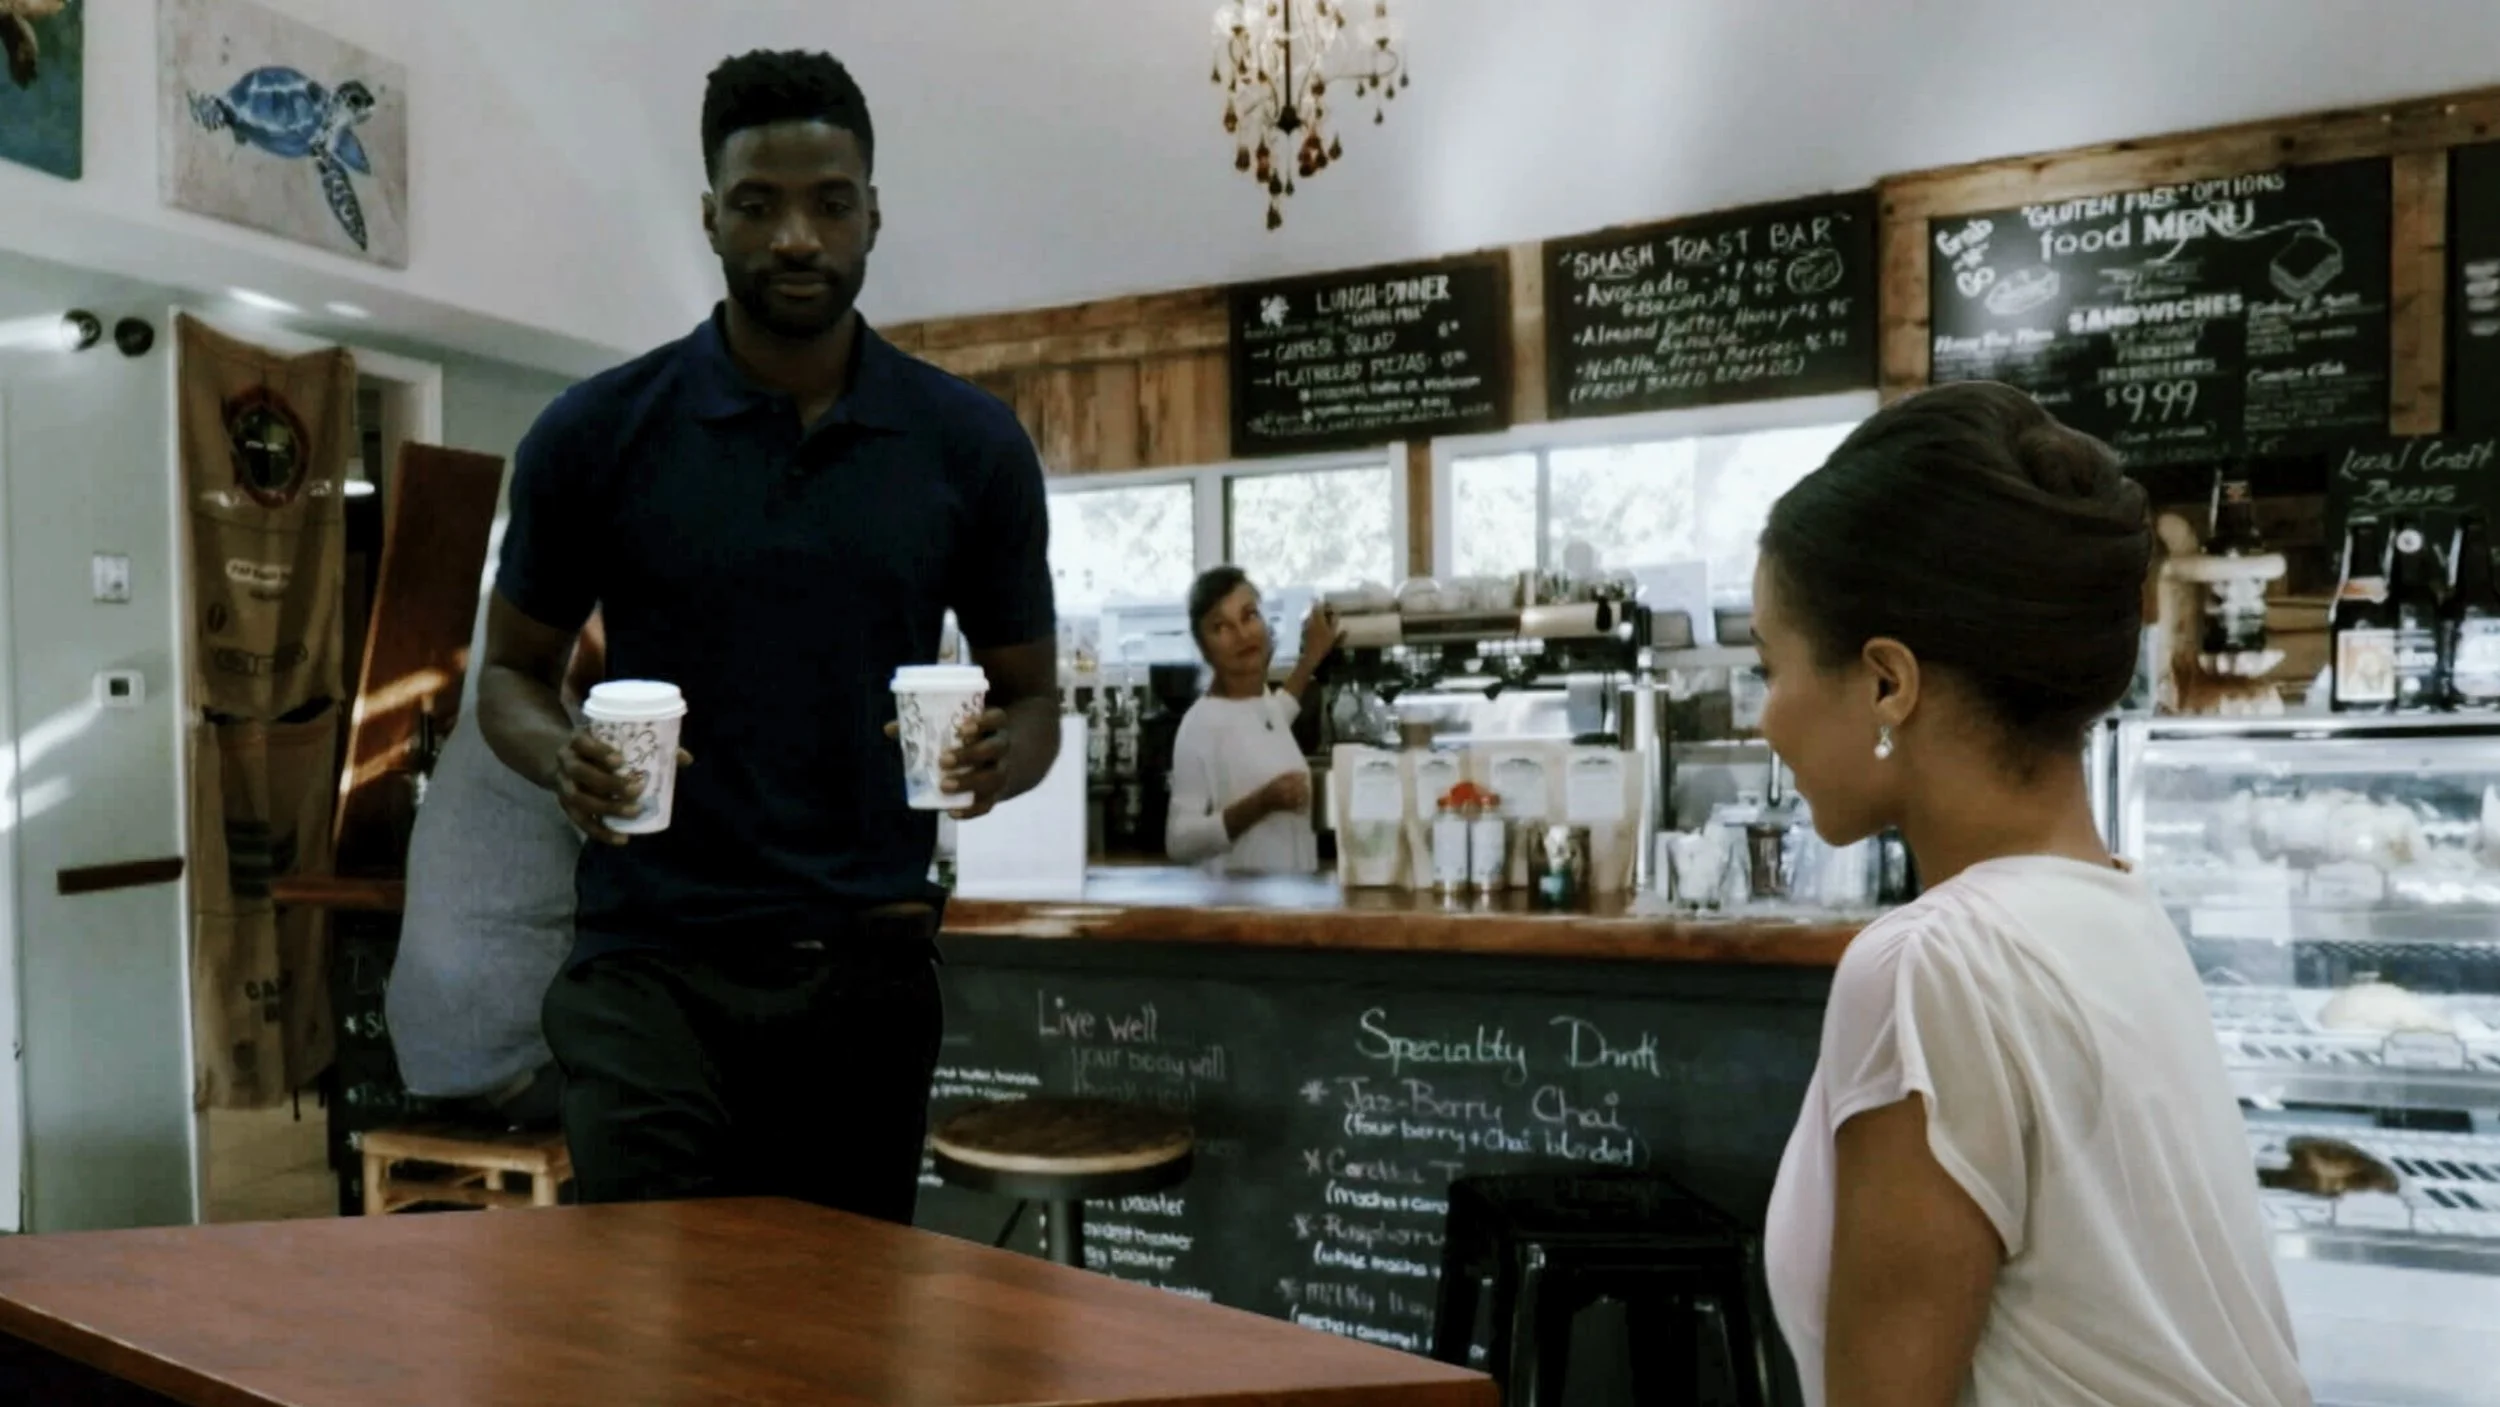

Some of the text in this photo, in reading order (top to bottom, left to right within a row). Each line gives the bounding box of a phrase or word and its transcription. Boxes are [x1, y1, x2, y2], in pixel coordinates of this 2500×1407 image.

[2192, 173, 2286, 203] OPTIONS
[1573, 215, 1832, 281] SMASH TOAST BAR
[1936, 218, 1994, 257] Grab
[2039, 199, 2256, 260] food MENU
[1586, 270, 1690, 308] Avocado
[1956, 266, 1996, 297] Go
[1581, 319, 1660, 348] Almond
[2067, 292, 2244, 334] SANDWICHES
[2105, 379, 2198, 424] $9.99
[2339, 439, 2498, 482] Local Craft
[2352, 478, 2458, 506] Beers
[1037, 989, 1159, 1044] Live well
[1128, 1052, 1186, 1083] body
[1188, 1044, 1227, 1081] will
[1353, 1007, 1530, 1087] Specialty
[1336, 1075, 1628, 1132] Jaz-Berry Chai
